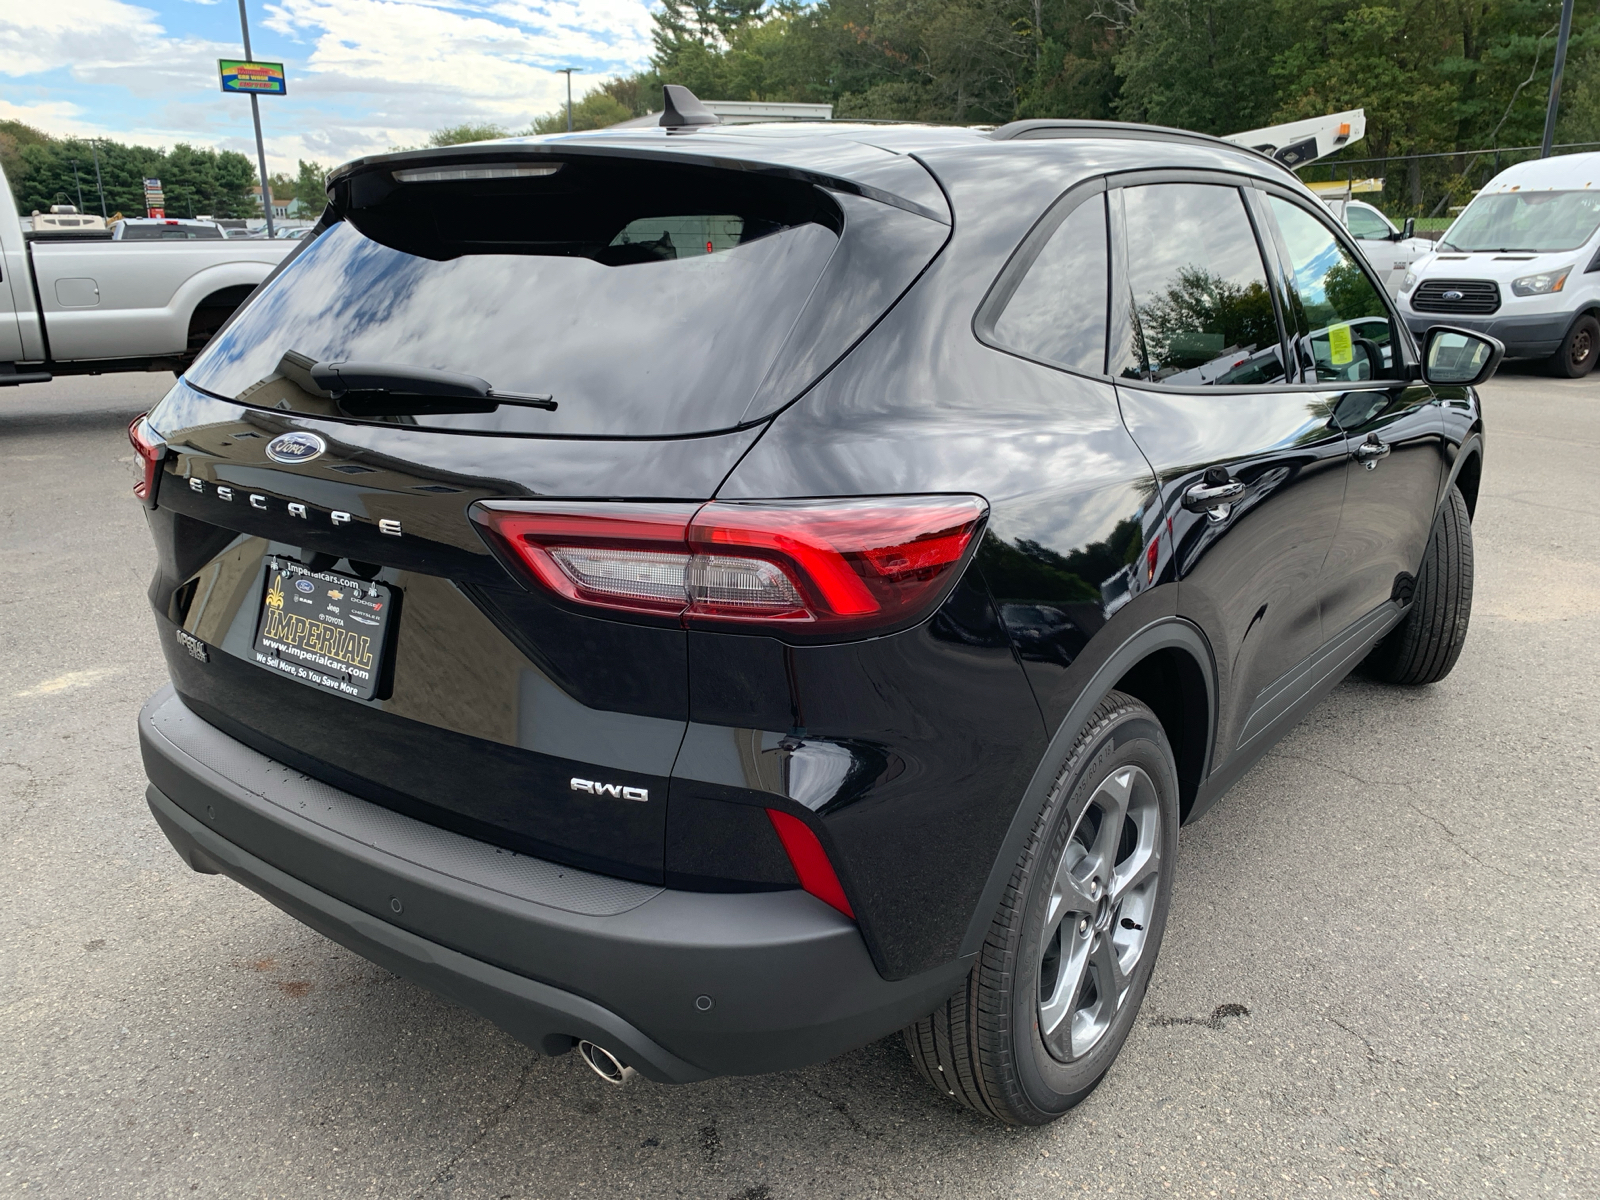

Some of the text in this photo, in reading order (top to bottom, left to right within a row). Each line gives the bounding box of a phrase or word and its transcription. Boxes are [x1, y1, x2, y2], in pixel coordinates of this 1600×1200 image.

[275, 436, 310, 455] Ford
[189, 477, 402, 537] ESCAPE
[325, 614, 344, 627] TOYOTA
[326, 603, 340, 614] Jeep
[351, 608, 381, 621] CHRYSLER
[264, 608, 372, 669] IMPERIAL
[262, 638, 369, 680] www.imperialcars.com
[256, 652, 359, 697] We Sell More, So You Save More
[570, 777, 649, 803] AWD
